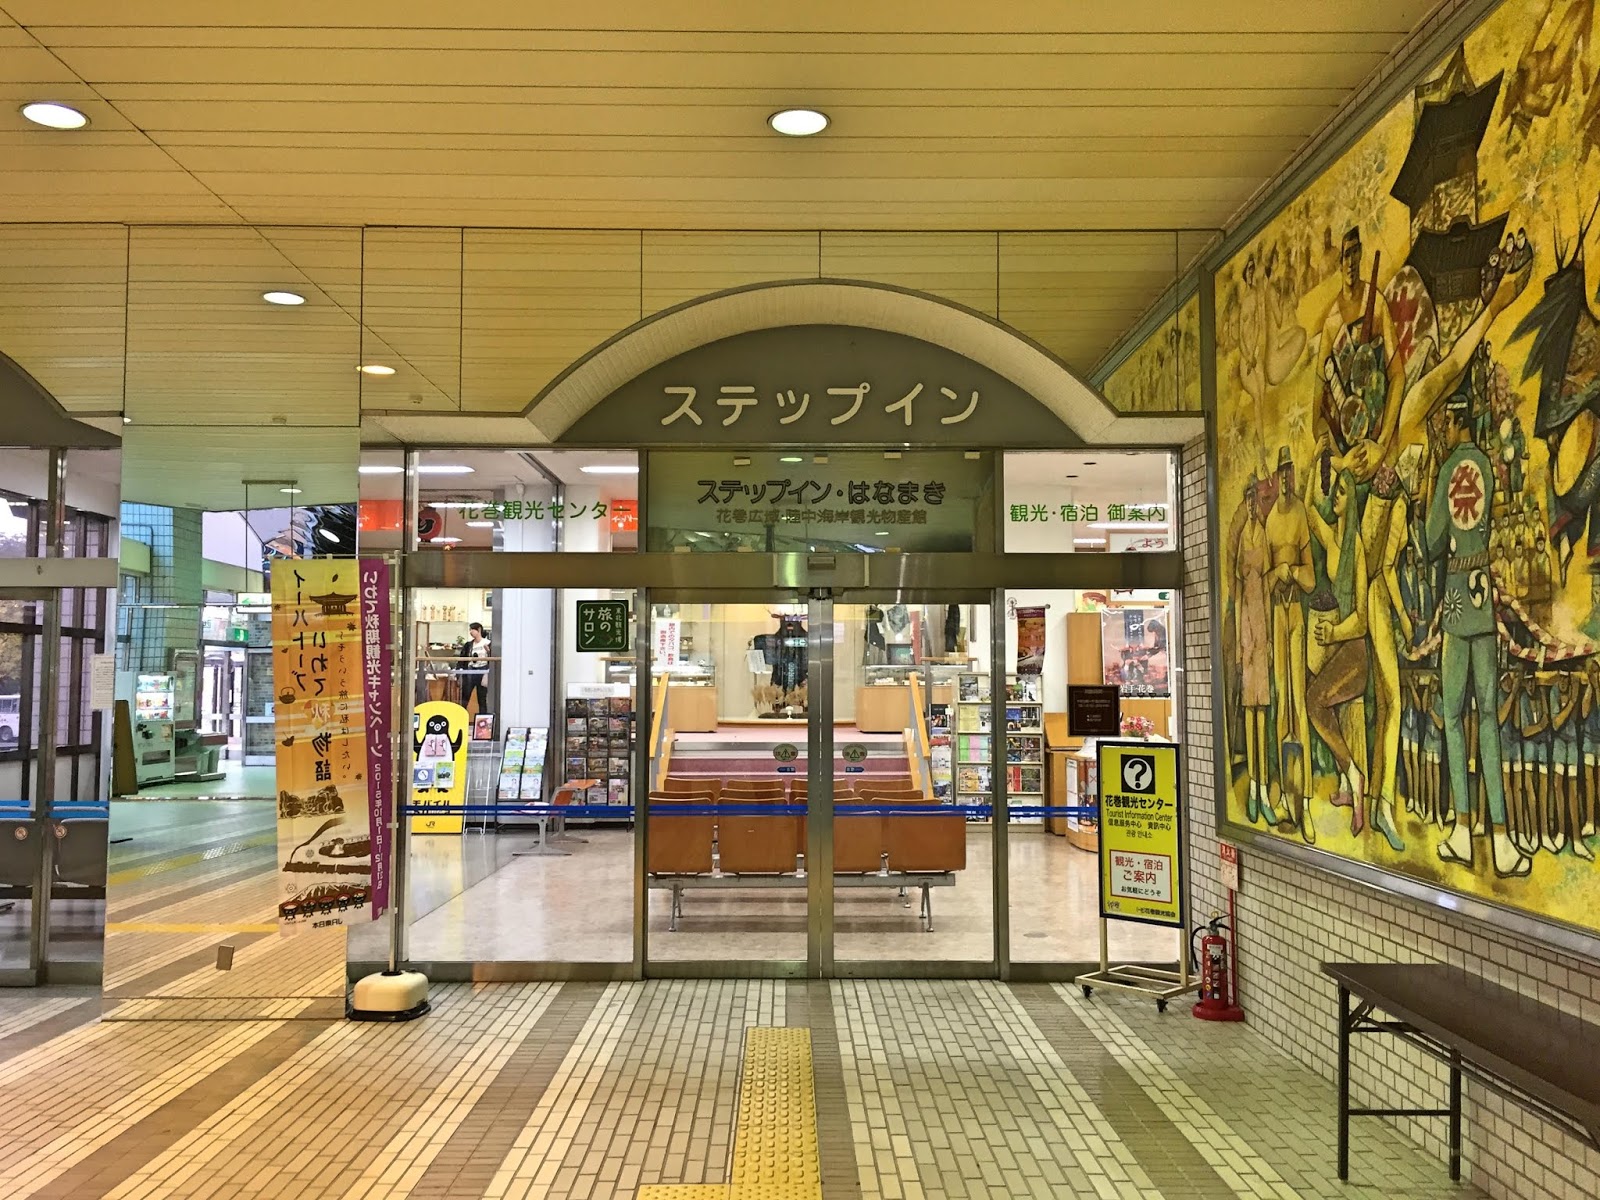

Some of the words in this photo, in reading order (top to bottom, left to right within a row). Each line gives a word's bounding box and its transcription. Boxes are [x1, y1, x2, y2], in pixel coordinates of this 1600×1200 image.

[661, 381, 979, 426] ステップイン
[697, 479, 946, 505] ステップイン・はなまき
[1449, 465, 1483, 520] 祭
[458, 500, 631, 520] 花巻観光センター
[1010, 503, 1098, 522] 観光・宿泊
[1107, 503, 1166, 522] 御案内
[583, 607, 596, 645] サロン
[597, 606, 613, 632] 旅の
[1105, 794, 1173, 811] 花巻観光センター
[1106, 809, 1124, 818] Tourist
[1125, 810, 1155, 820] Information
[1155, 812, 1173, 822] Center
[1115, 855, 1163, 871] 観光・宿泊
[1123, 869, 1156, 885] ご案内
